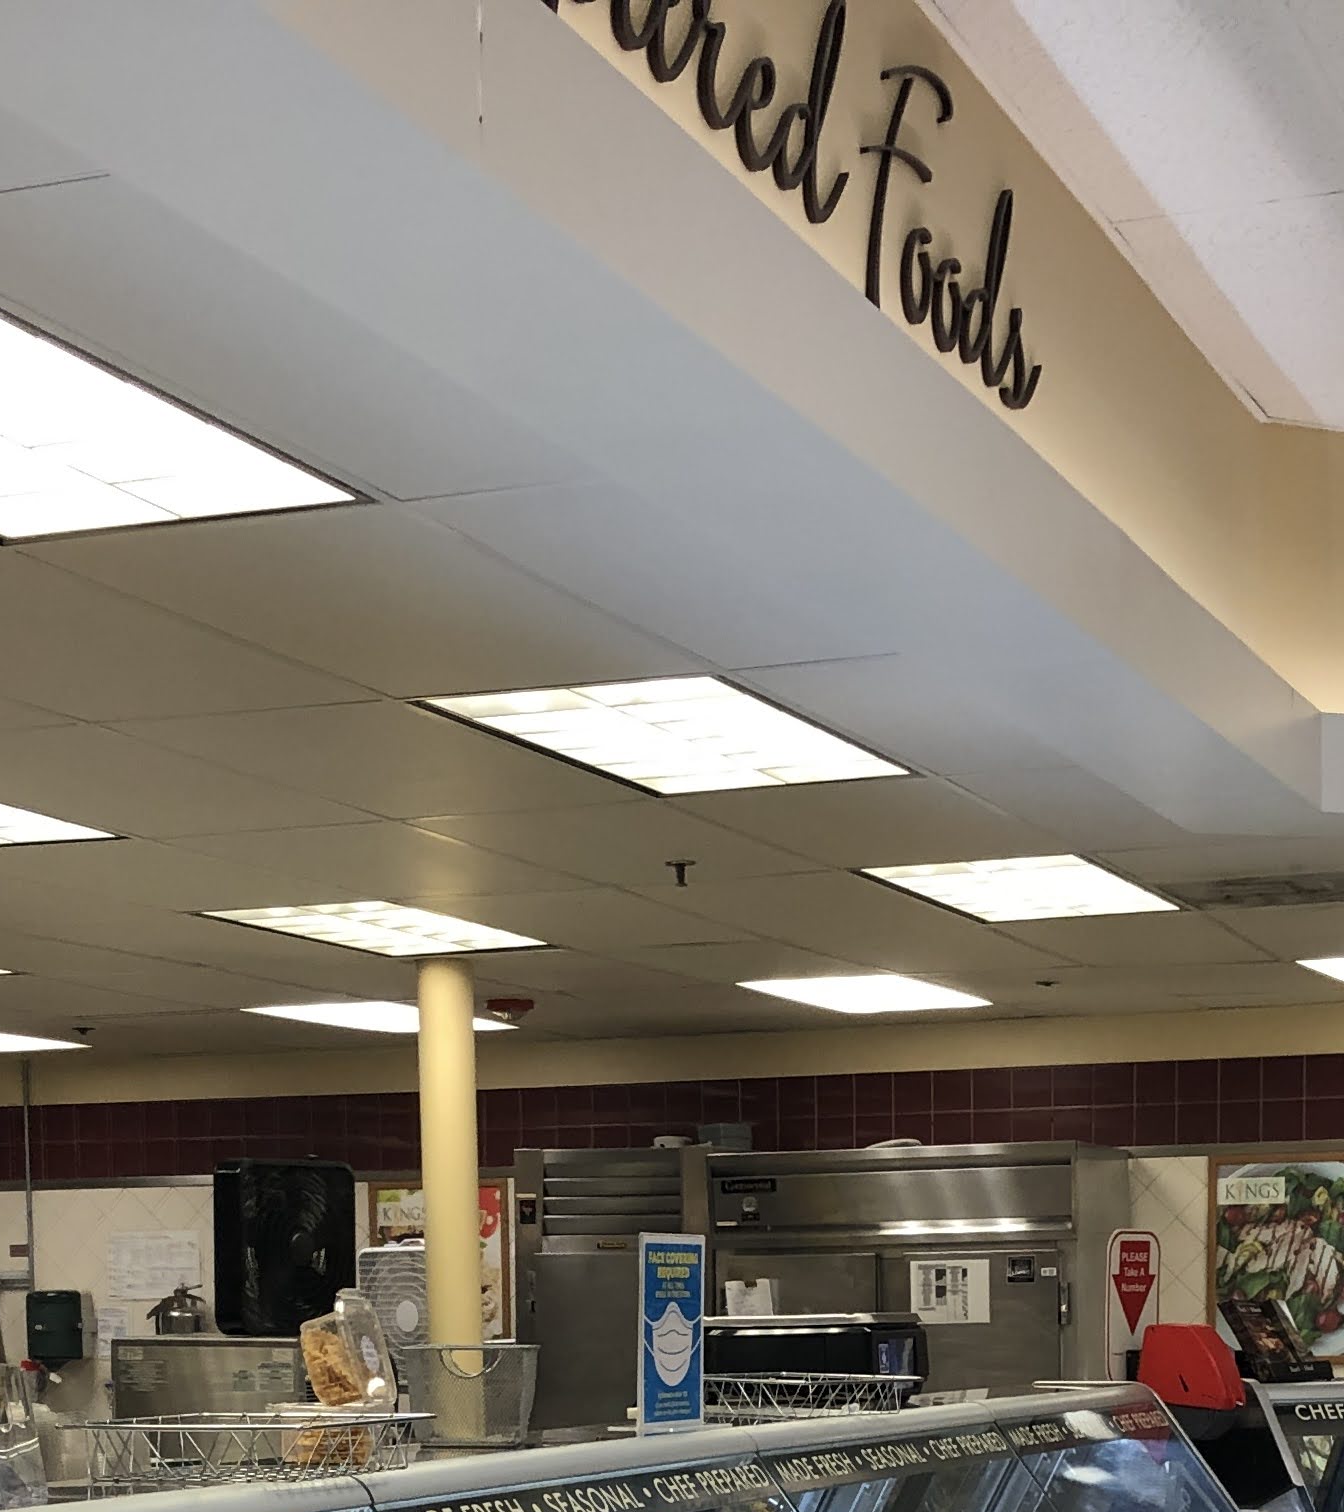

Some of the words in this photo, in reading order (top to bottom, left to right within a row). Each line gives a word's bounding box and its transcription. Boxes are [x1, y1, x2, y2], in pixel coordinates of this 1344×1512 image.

[541, 0, 849, 224] ared
[859, 64, 1042, 410] Foods
[1121, 1252, 1148, 1262] PLEASE
[1123, 1267, 1139, 1277] Take
[1139, 1267, 1145, 1276] A
[1121, 1283, 1147, 1293] Number
[773, 1455, 815, 1484] MADE
[812, 1449, 856, 1478] FRESH
[859, 1442, 928, 1472] SEASONAL
[928, 1436, 957, 1461] CHEF
[955, 1430, 1007, 1458] PREPARED
[653, 1471, 697, 1504] CHEF
[698, 1463, 771, 1499] PREPARED
